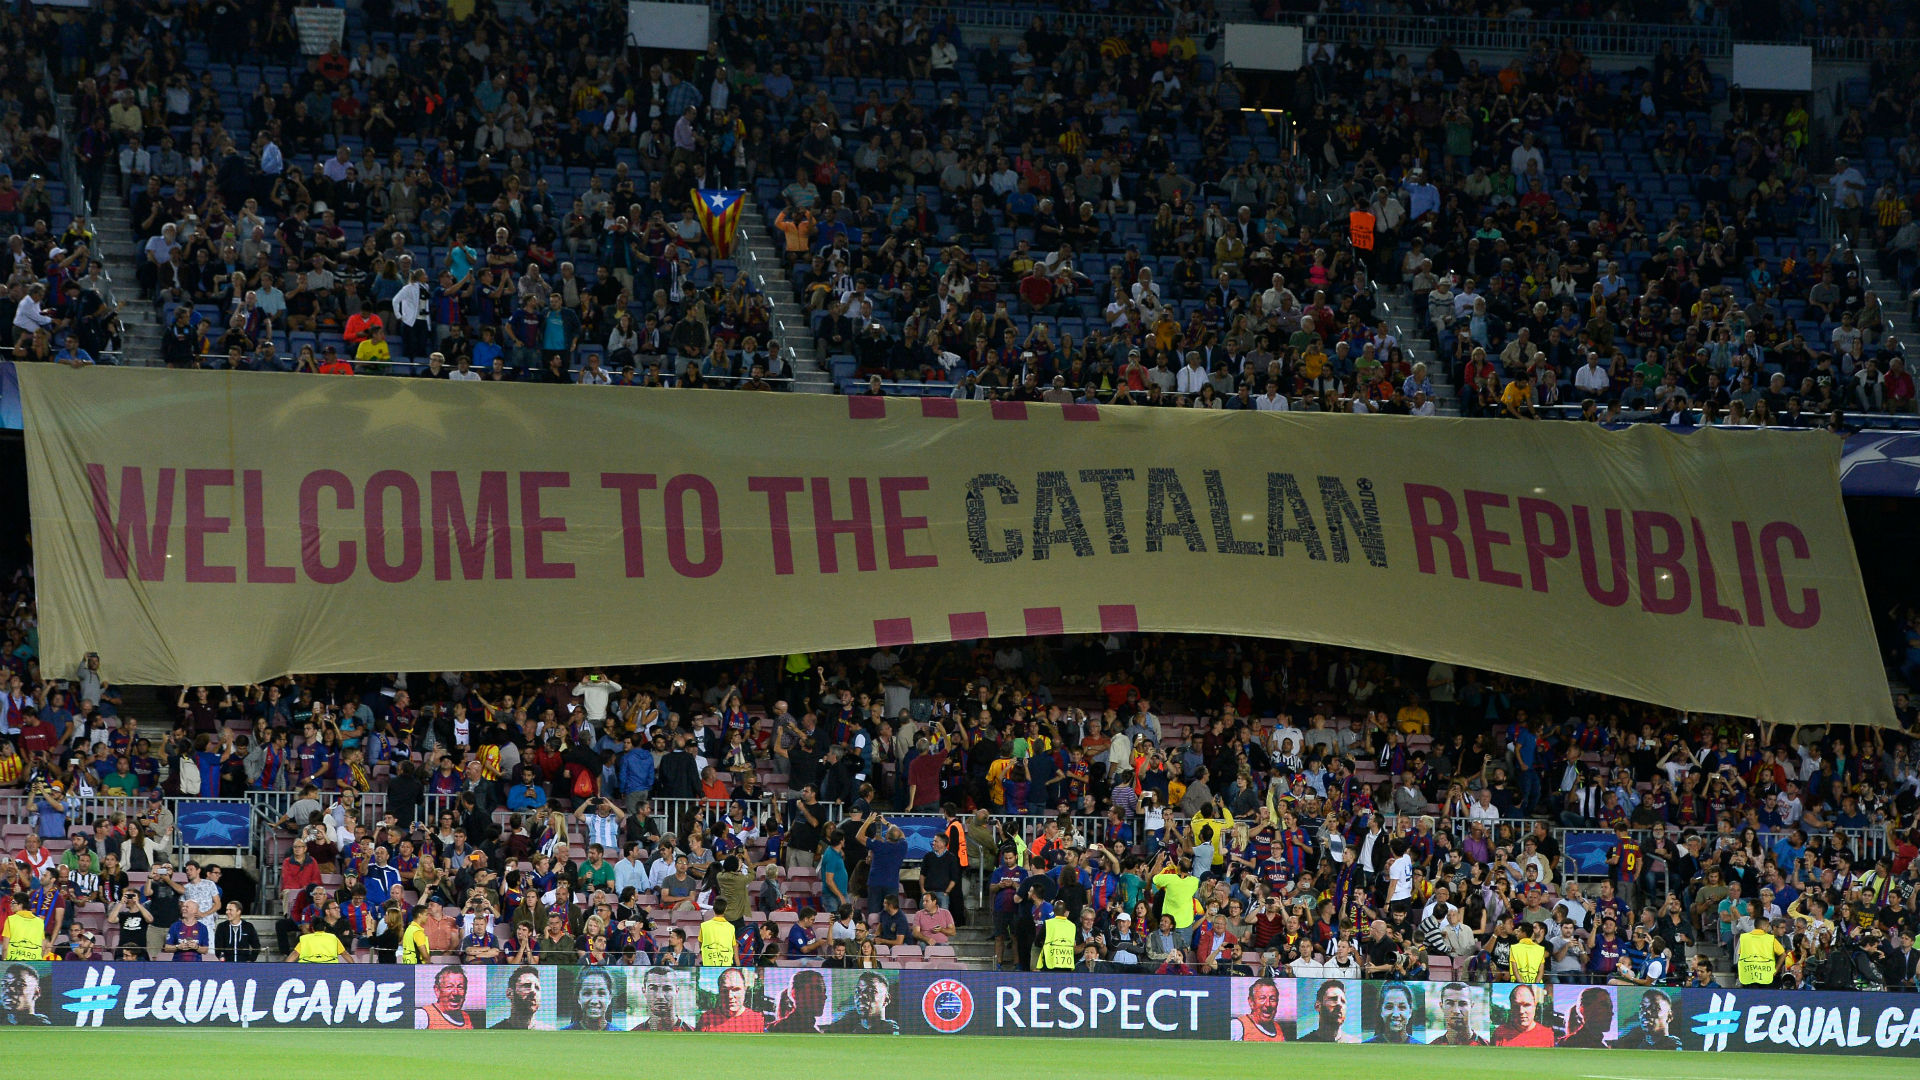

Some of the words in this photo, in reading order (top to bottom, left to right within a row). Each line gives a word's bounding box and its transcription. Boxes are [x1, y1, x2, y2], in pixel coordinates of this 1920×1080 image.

[1037, 470, 1065, 480] HUMAN
[1147, 474, 1179, 483] RIGHTS
[1037, 478, 1068, 488] RIGHTS
[1359, 490, 1380, 522] WORLD
[87, 463, 576, 584] WELCOME
[600, 472, 723, 578] TO
[748, 476, 939, 575] THE
[965, 467, 1388, 569] CATALAN
[1403, 482, 1822, 630] REPUBLIC
[1033, 535, 1070, 545] WELFARE
[1627, 853, 1635, 870] 9
[1055, 956, 1072, 965] 170
[932, 982, 963, 996] UEFA
[273, 978, 405, 1025] GAME
[996, 986, 1209, 1032] RESPECT
